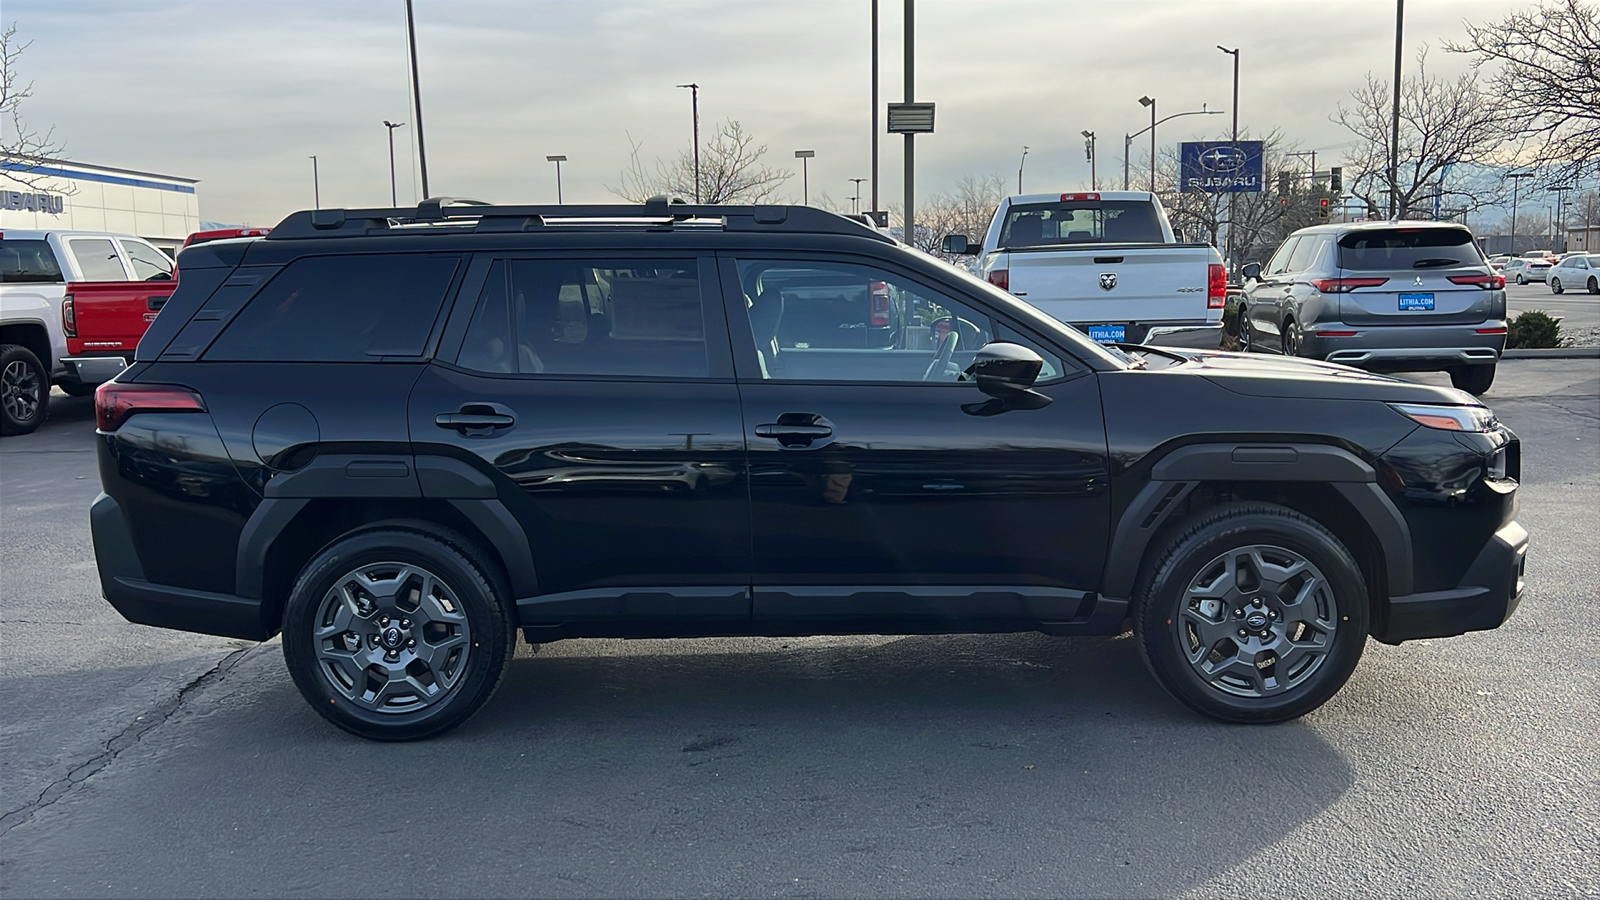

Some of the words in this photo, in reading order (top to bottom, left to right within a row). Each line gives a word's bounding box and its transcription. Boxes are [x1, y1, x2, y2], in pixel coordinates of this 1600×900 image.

[1188, 177, 1256, 187] SUBARU
[1400, 298, 1434, 306] LITHIA.COM
[1089, 330, 1125, 339] LITHIA.COM
